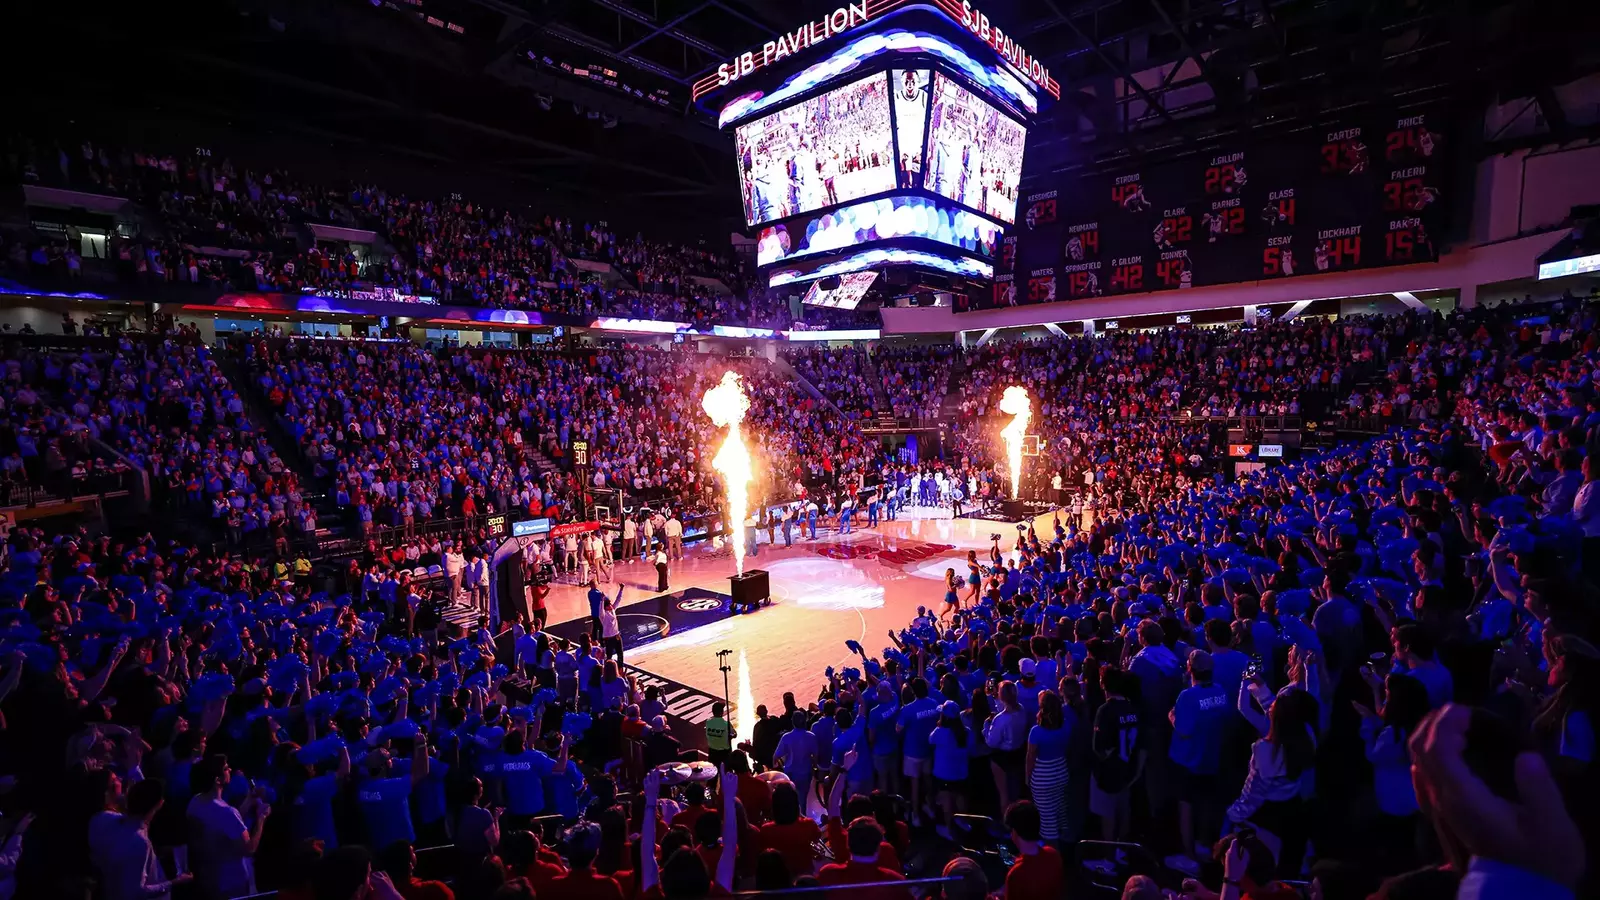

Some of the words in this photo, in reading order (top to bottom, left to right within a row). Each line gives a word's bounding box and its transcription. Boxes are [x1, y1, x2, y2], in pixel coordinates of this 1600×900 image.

[718, 51, 755, 86] SJB
[763, 1, 868, 66] PAVILION
[962, 1, 991, 41] SJB
[994, 26, 1049, 90] PAVILION
[1397, 115, 1425, 129] PRICE
[1327, 128, 1361, 142] CARTER
[195, 147, 212, 157] 214
[1115, 173, 1140, 185] STROUD
[1205, 164, 1235, 194] 22
[1269, 188, 1294, 200] GLASS
[1212, 198, 1241, 209] BARNES
[1163, 207, 1185, 217] CLARK
[1279, 199, 1296, 225] 4
[1221, 207, 1245, 233] 12
[1389, 218, 1420, 230] BAKER
[1068, 223, 1098, 235] NEUMANN
[1162, 216, 1192, 244] 22
[1318, 226, 1361, 240] LOCKHART
[1079, 231, 1099, 256] 14
[1267, 235, 1293, 247] SESAY
[1384, 230, 1414, 261] 15
[1160, 249, 1188, 260] CONNER
[1326, 237, 1361, 266] 44
[1065, 261, 1101, 273] SPRINGFIELD
[1119, 255, 1142, 266] GILLOM
[1263, 247, 1279, 275] 5
[1031, 267, 1054, 277] WATERS
[1113, 265, 1143, 289] 42
[573, 441, 587, 450] 20:00
[575, 450, 587, 465] 30
[487, 516, 505, 526] 20:00
[491, 525, 502, 534] 30
